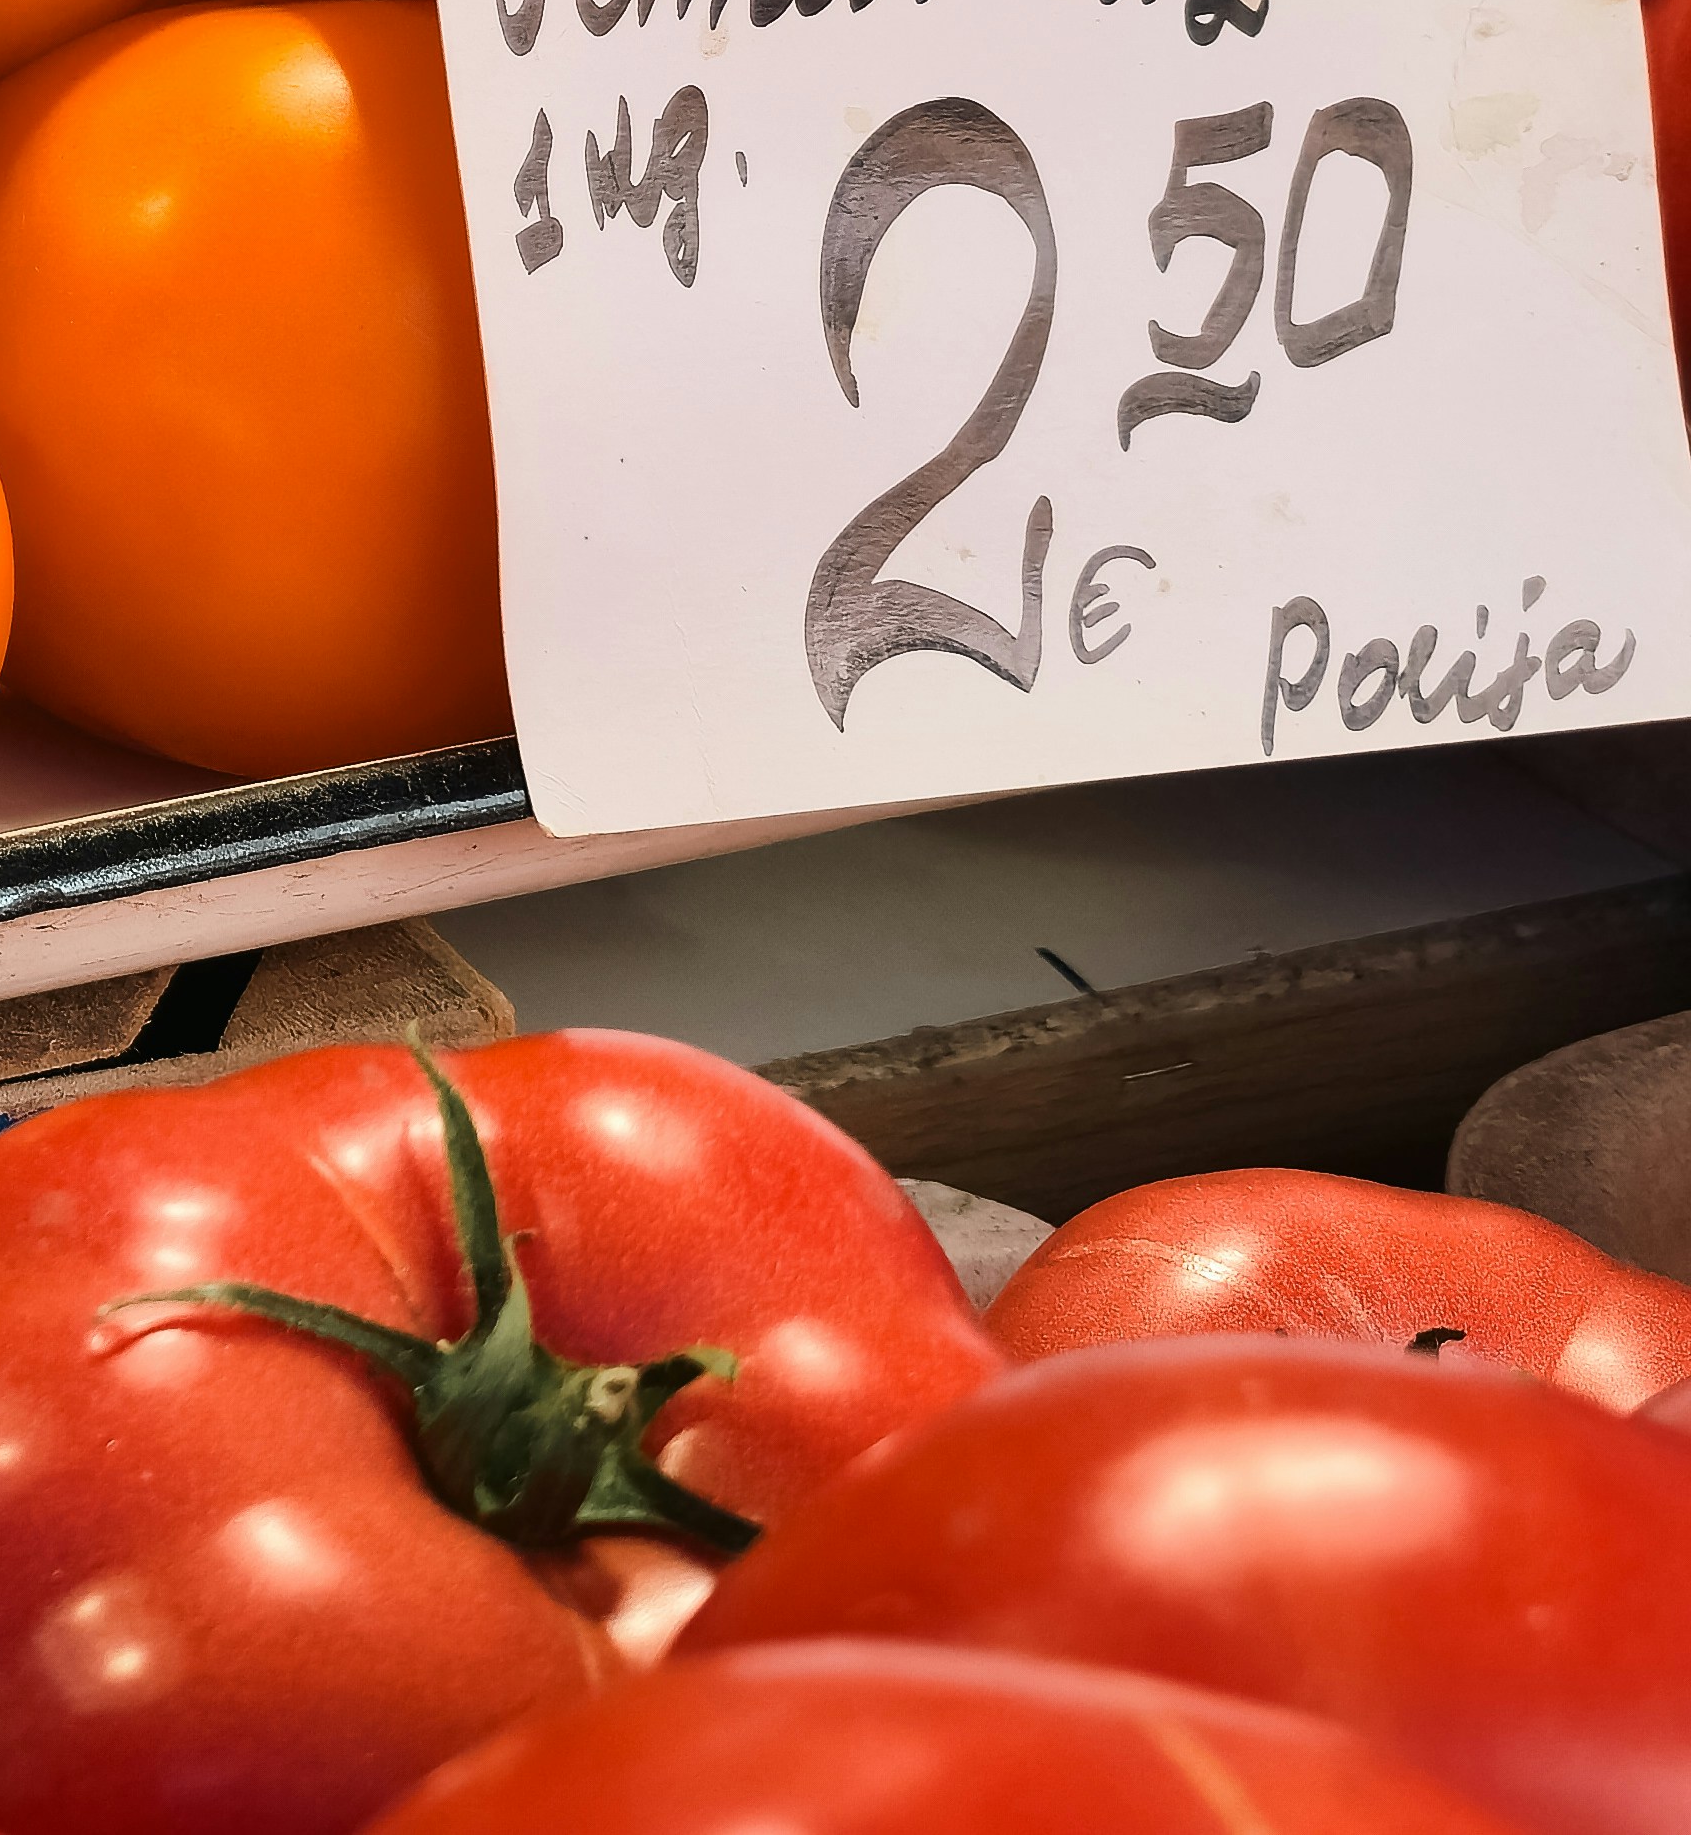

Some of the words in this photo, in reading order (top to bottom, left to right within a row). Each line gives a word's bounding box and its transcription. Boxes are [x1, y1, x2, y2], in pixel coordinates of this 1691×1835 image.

[513, 107, 565, 276] 1
[804, 96, 1059, 735] 2
[1148, 96, 1415, 370] 50
